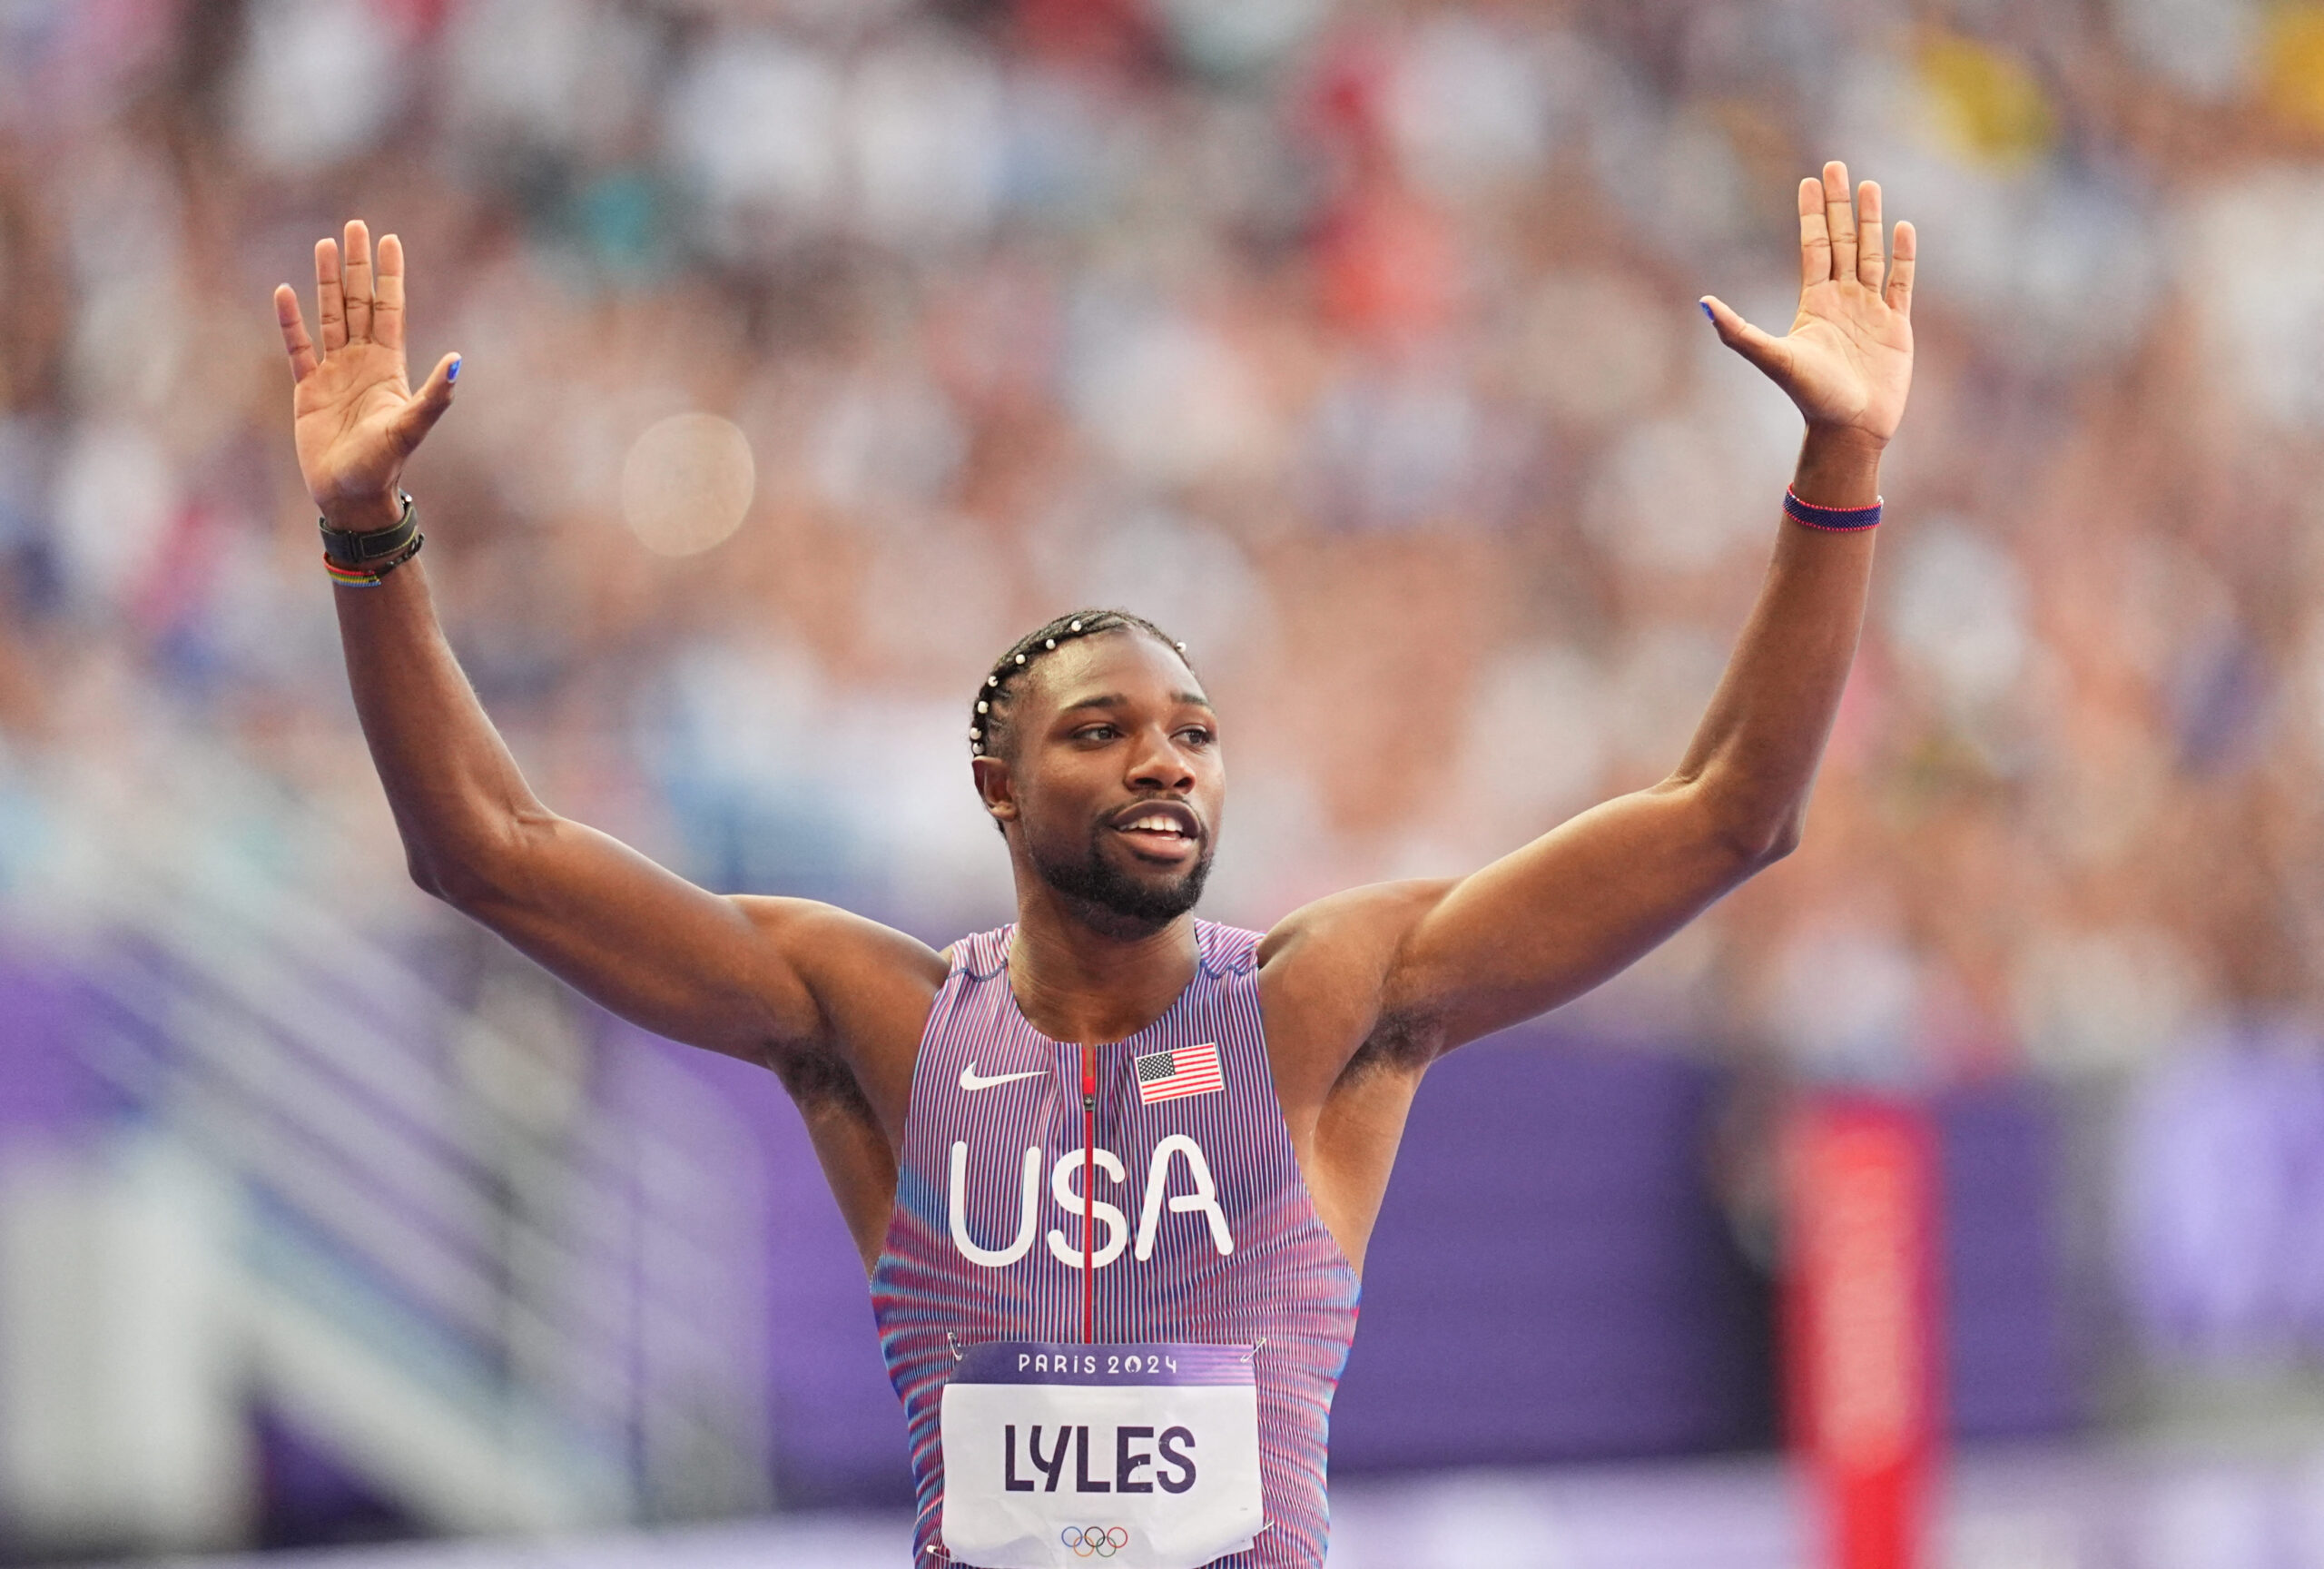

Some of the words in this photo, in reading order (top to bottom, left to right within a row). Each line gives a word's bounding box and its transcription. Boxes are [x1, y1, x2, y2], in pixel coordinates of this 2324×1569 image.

[949, 1134, 1234, 1268] USA
[1108, 1355, 1177, 1374] 2024
[1005, 1425, 1196, 1494] LYLES
